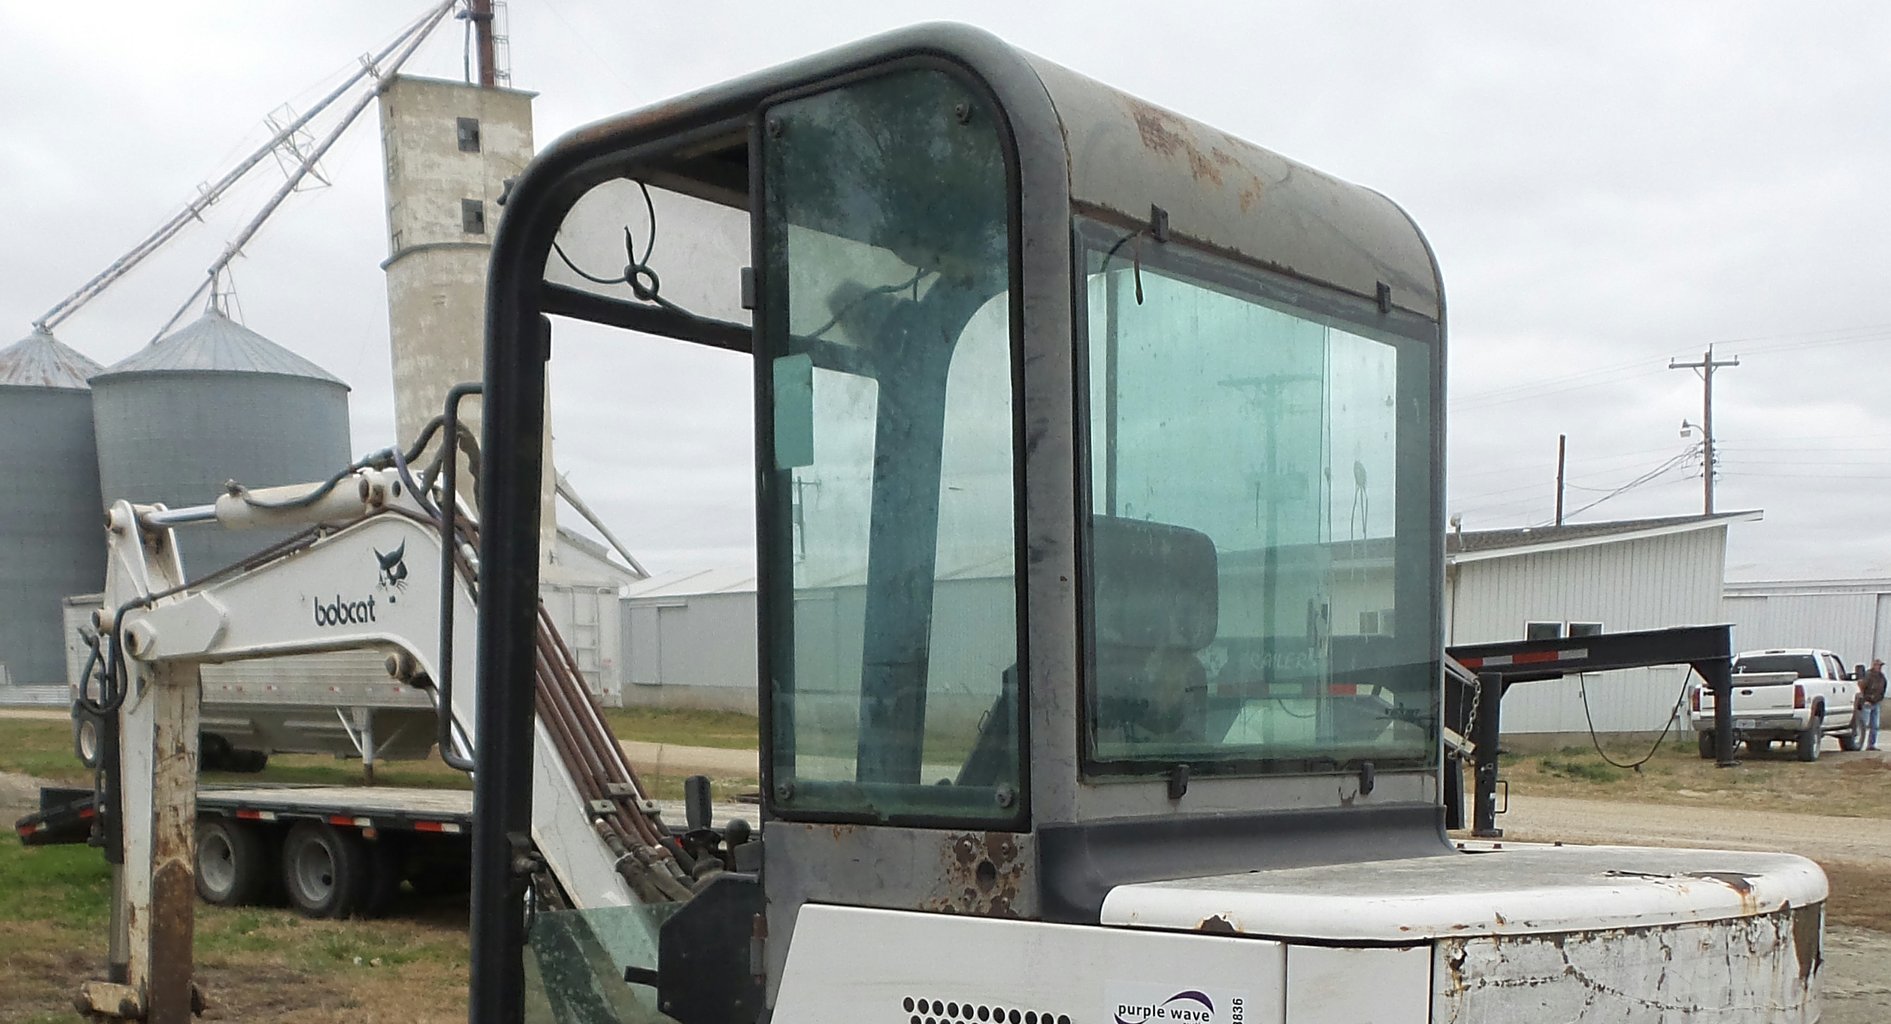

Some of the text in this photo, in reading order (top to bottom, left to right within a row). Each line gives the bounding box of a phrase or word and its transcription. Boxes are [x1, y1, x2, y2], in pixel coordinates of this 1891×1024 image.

[314, 594, 376, 627] bobcat
[1118, 1004, 1210, 1022] purple wave
